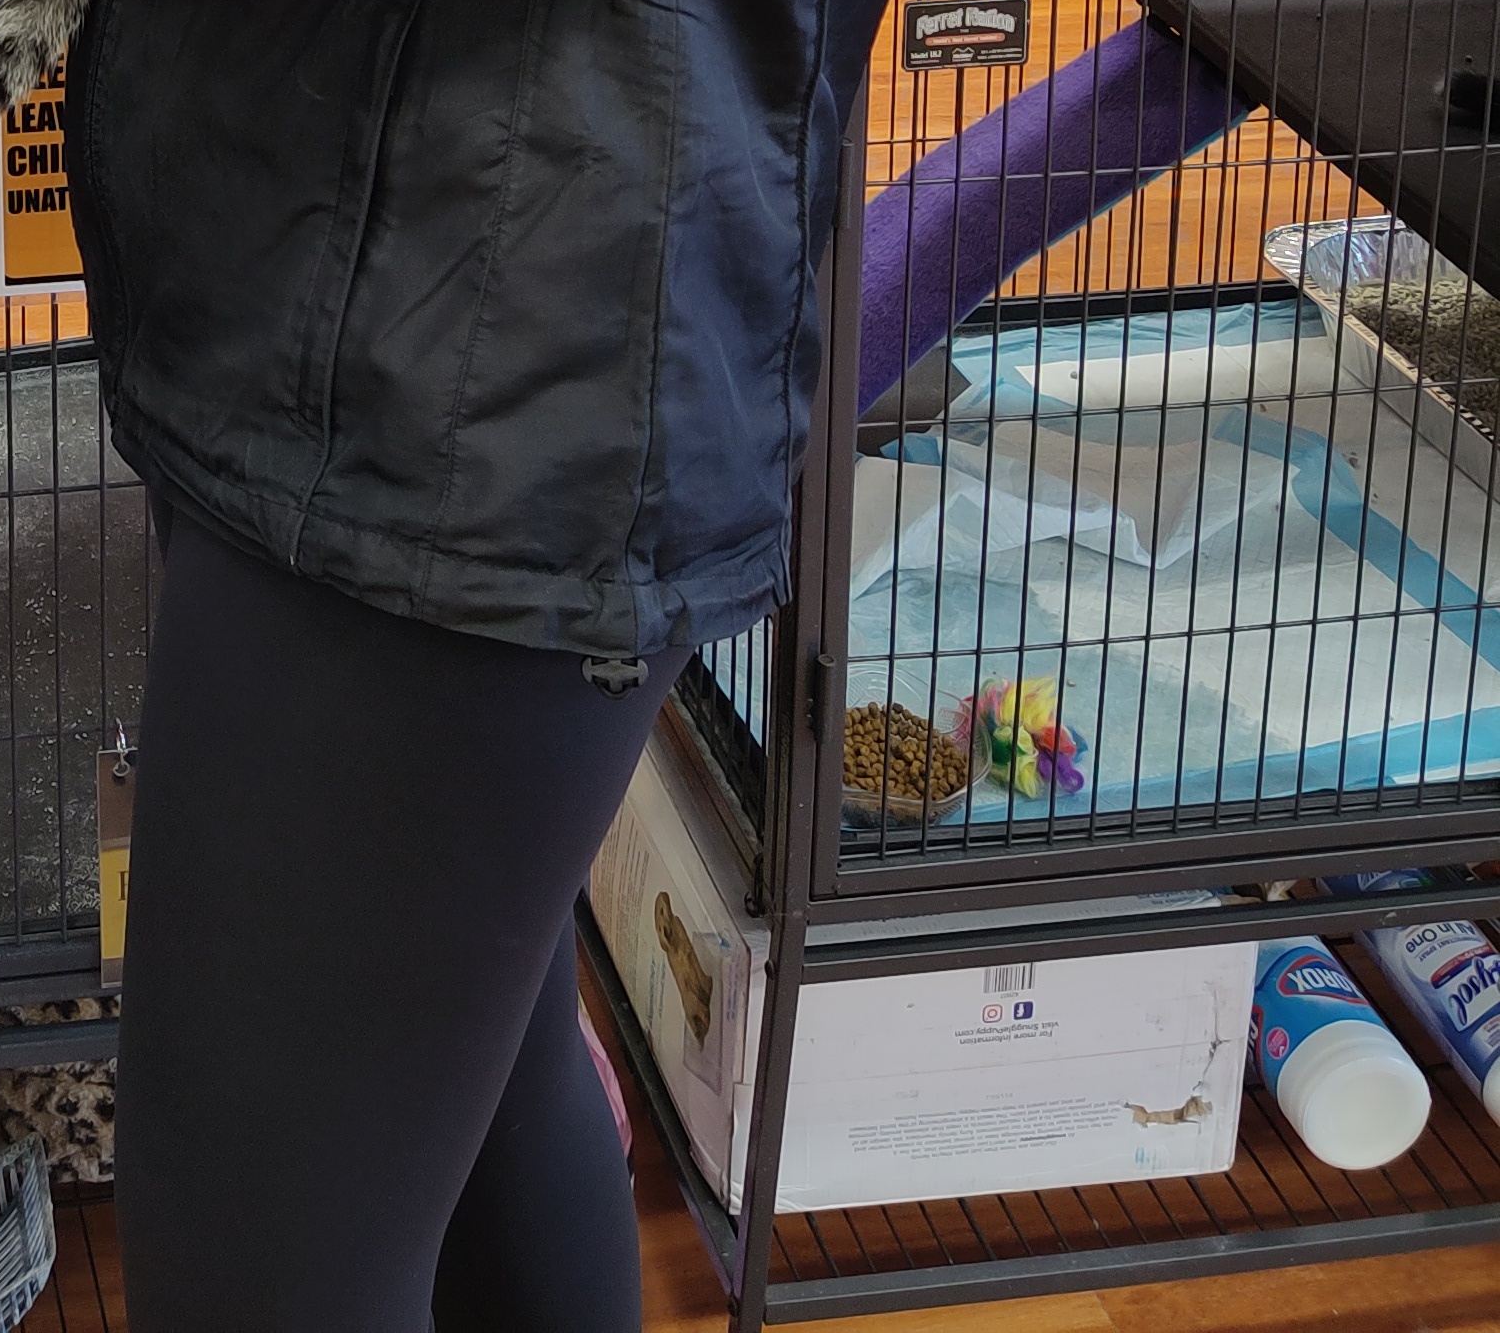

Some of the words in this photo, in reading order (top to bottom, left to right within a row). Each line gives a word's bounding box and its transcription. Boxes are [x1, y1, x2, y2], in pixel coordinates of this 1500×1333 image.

[915, 7, 964, 40] Ferret
[965, 6, 1016, 33] Nation
[1405, 928, 1438, 955] One
[955, 1023, 1039, 1038] SnugglePuppy.com
[1042, 1021, 1059, 1030] visit
[1013, 1031, 1037, 1040] more
[1039, 1029, 1053, 1038] For
[959, 1034, 1011, 1045] information
